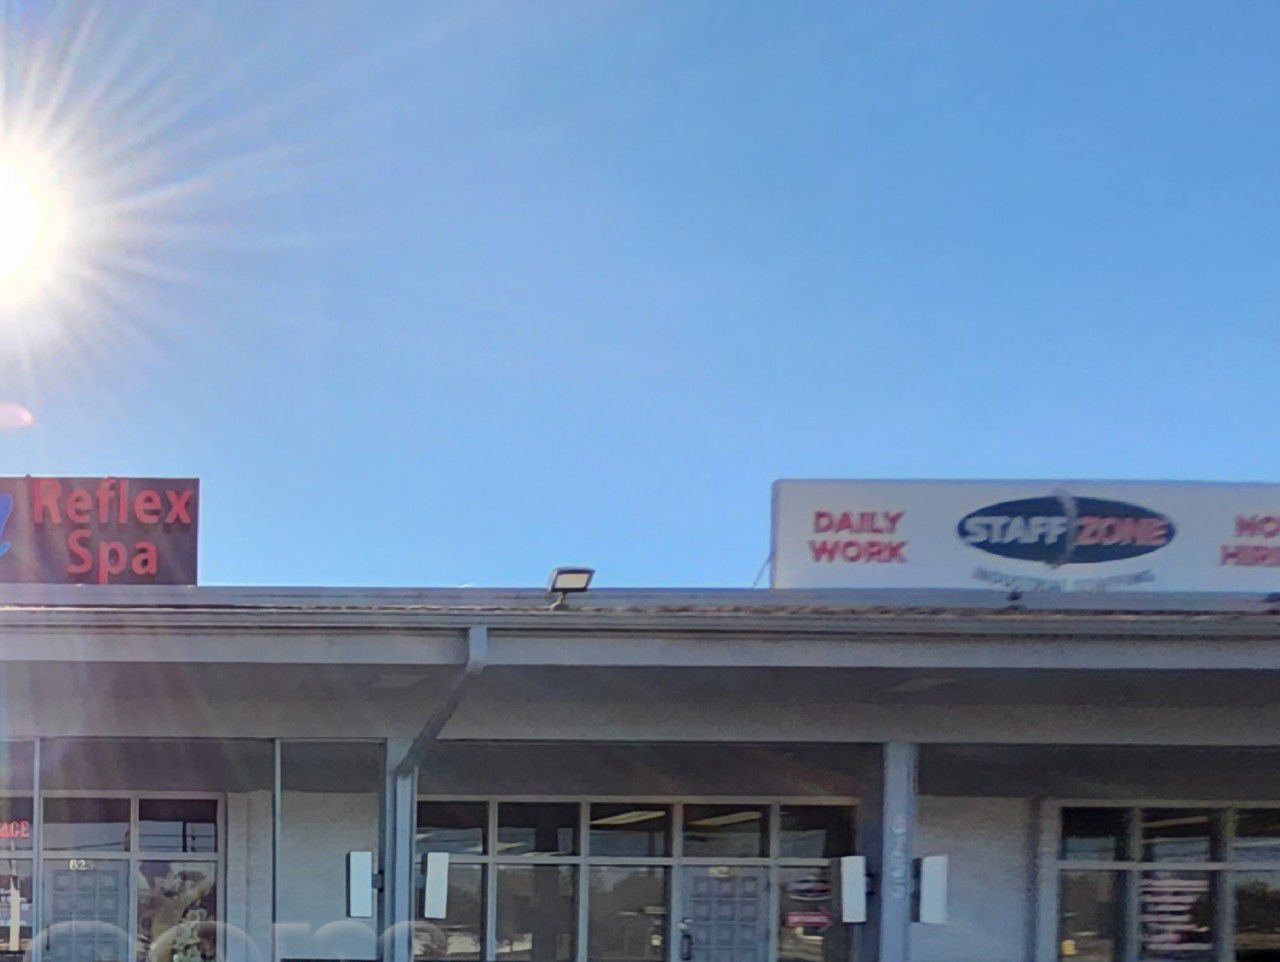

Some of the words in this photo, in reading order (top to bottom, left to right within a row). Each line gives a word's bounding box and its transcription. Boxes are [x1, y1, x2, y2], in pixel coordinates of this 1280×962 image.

[33, 477, 192, 524] Reflex
[812, 511, 905, 534] DAILY
[964, 515, 1067, 544] STAFF
[1073, 515, 1170, 546] ZONE
[66, 529, 159, 585] Spa
[808, 541, 908, 563] WORK
